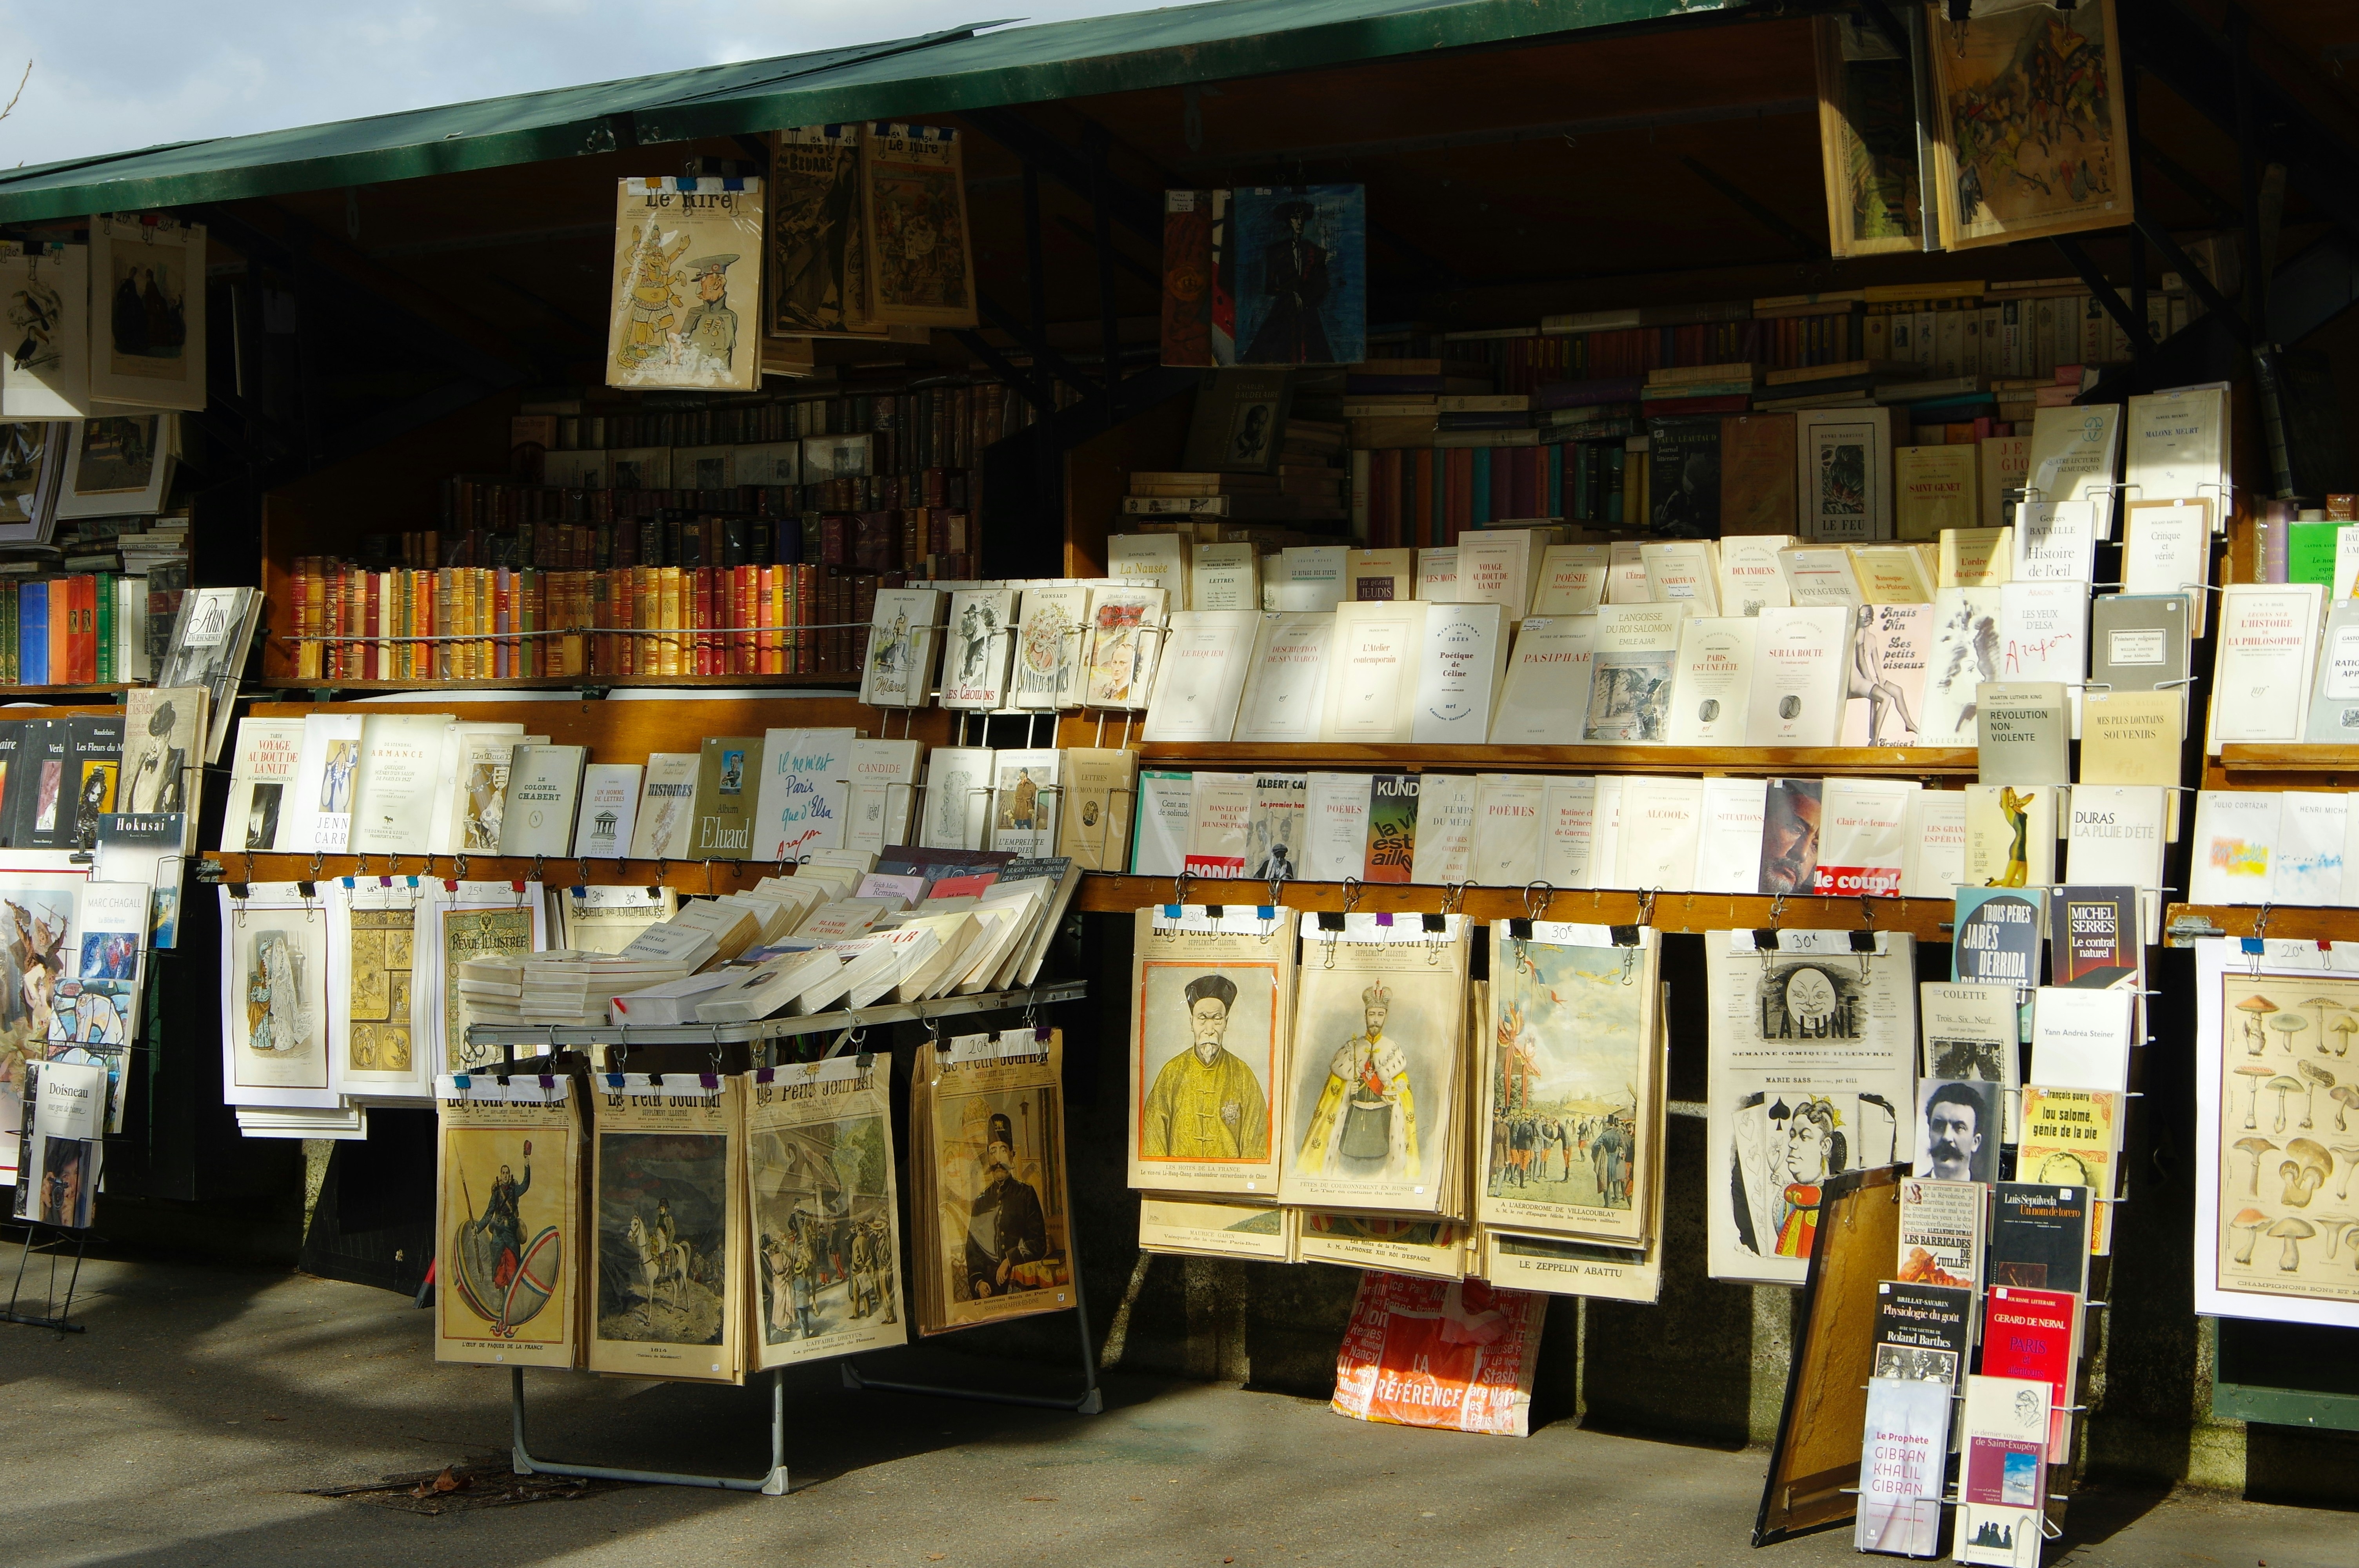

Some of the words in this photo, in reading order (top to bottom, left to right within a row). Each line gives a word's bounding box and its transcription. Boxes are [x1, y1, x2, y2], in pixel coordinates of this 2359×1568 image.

[790, 154, 833, 172] BEURRE
[2176, 427, 2199, 436] MEURT
[1823, 521, 1838, 530] LE
[1843, 520, 1865, 530] FEU
[2040, 515, 2065, 523] Georges
[2030, 526, 2075, 535] BATAILLE
[2151, 532, 2181, 541] Critique
[2028, 547, 2075, 559] Histoire
[2155, 551, 2174, 560] vérité
[1120, 563, 1132, 574] La
[1135, 563, 1168, 573] Nausée
[1747, 567, 1776, 575] INDIENS
[2028, 564, 2043, 577] de
[2046, 564, 2071, 577] l'œil
[1359, 587, 1392, 598] JEUDIS
[1619, 612, 1663, 622] L'ANGOISSE
[1880, 606, 1917, 619] Anaïs
[1606, 625, 1617, 633] DU
[1619, 624, 1631, 633] ROI
[1633, 624, 1672, 632] SALOMON
[1883, 619, 1905, 631] Nin
[2241, 619, 2293, 628] L'HISTOIRE
[1888, 637, 1911, 649] Les
[2228, 637, 2239, 646] LA
[2242, 637, 2302, 646] PHILOSOPHIE
[1440, 651, 1474, 660] Poétique
[1524, 652, 1591, 664] PASIPHAÉ
[1884, 650, 1916, 659] petits
[1692, 663, 1705, 671] EST
[1706, 663, 1719, 671] UNE
[1722, 662, 1739, 671] FÊTE
[1884, 662, 1925, 670] oiseaux
[1443, 670, 1467, 678] Céline
[874, 676, 906, 695] Nêne
[1991, 710, 2048, 720] RÉVOLUTION
[1991, 722, 2014, 731] NON-
[1991, 733, 2036, 742] VIOLENTE
[2104, 730, 2156, 739] SOUVENIRS
[76, 742, 86, 752] Les
[88, 742, 107, 752] Fleurs
[109, 742, 116, 752] du
[259, 740, 291, 751] VOYAGE
[248, 752, 259, 762] AU
[261, 751, 284, 762] BOUT
[286, 751, 298, 762] DE
[371, 749, 423, 758] ARMANCE
[254, 764, 265, 774] LA
[267, 764, 289, 774] NUIT
[859, 764, 900, 773] CANDIDE
[648, 783, 693, 798] HISTOIRES
[1256, 779, 1289, 790] ALBERT
[518, 793, 561, 802] CHABERT
[717, 804, 738, 814] Album
[1489, 804, 1535, 816] POÈMES
[116, 817, 165, 831] Hokusai
[2076, 812, 2115, 824] DURAS
[700, 817, 750, 849] Eluard
[2075, 826, 2090, 838] LA
[2093, 826, 2122, 838] PLUIE
[2126, 824, 2154, 839] D'ÉTÉ
[88, 898, 107, 908] MARC
[109, 898, 141, 909] CHAGALL
[1983, 906, 2005, 924] TROIS
[2007, 904, 2031, 924] PÈRES
[2072, 907, 2115, 920] MICHEL
[2073, 920, 2115, 933] SERRES
[1964, 920, 1999, 950] JABÈS
[451, 933, 481, 951] REVUE
[480, 933, 527, 949] ILLUSTRÉE
[2073, 936, 2083, 947] Le
[2086, 937, 2115, 948] contrat
[631, 944, 671, 956] CONDOTTIÈRE
[2080, 947, 2109, 958] naturel
[1979, 951, 2026, 978] DERRIDA
[1943, 990, 1988, 1000] COLETTE
[1763, 996, 1792, 1039] LA
[1800, 996, 1860, 1039] LUNE
[2045, 1028, 2061, 1036] Yann
[2063, 1029, 2088, 1037] Andréa
[2090, 1029, 2114, 1038] Steiner
[49, 1082, 88, 1099] Doisneau
[2043, 1107, 2056, 1122] lou
[2059, 1110, 2093, 1123] salomé,
[2034, 1125, 2058, 1139] génie
[2061, 1125, 2071, 1138] de
[2074, 1127, 2082, 1138] la
[2085, 1127, 2097, 1140] vie
[2004, 1193, 2021, 1204] Luis
[2021, 1194, 2057, 1207] Sepúlveda
[1509, 1202, 1552, 1211] L'AÉRODROME
[1568, 1208, 1616, 1218] VILLACOUBLAY
[1904, 1235, 1919, 1245] LES
[1920, 1237, 1971, 1249] BARRICADES
[1345, 1245, 1374, 1256] ALPHONSE
[1961, 1249, 1971, 1258] DE
[1519, 1260, 1530, 1269] LE
[1536, 1262, 1579, 1274] ZEPPELIN
[1584, 1267, 1623, 1278] ABATTU
[1937, 1257, 1971, 1269] JUILLET
[2237, 1281, 2306, 1291] CHAMPIGNONS
[1883, 1305, 1928, 1322] Physiologie
[1930, 1310, 1941, 1320] du
[1942, 1312, 1960, 1324] goût
[1995, 1314, 2025, 1327] GERARD
[2027, 1316, 2037, 1327] DE
[2039, 1317, 2066, 1330] NERVAL
[1887, 1331, 1917, 1344] Roland
[1919, 1334, 1952, 1349] Barthes
[2010, 1336, 2047, 1354] PARIS
[1349, 1345, 1379, 1363] Nancy
[2023, 1354, 2030, 1364] et
[1414, 1354, 1429, 1374] LA
[2006, 1365, 2044, 1378] alentours
[1377, 1378, 1463, 1408] RÉFÉRENCE
[1876, 1432, 1887, 1441] Le
[1889, 1433, 1929, 1445] Prophète
[1976, 1438, 1986, 1447] de
[1988, 1439, 2038, 1453] Saint-Exupéry
[1876, 1446, 1926, 1463] GIBRAN
[1874, 1463, 1921, 1480] KHALIL
[1872, 1479, 1923, 1496] GIBRAN
